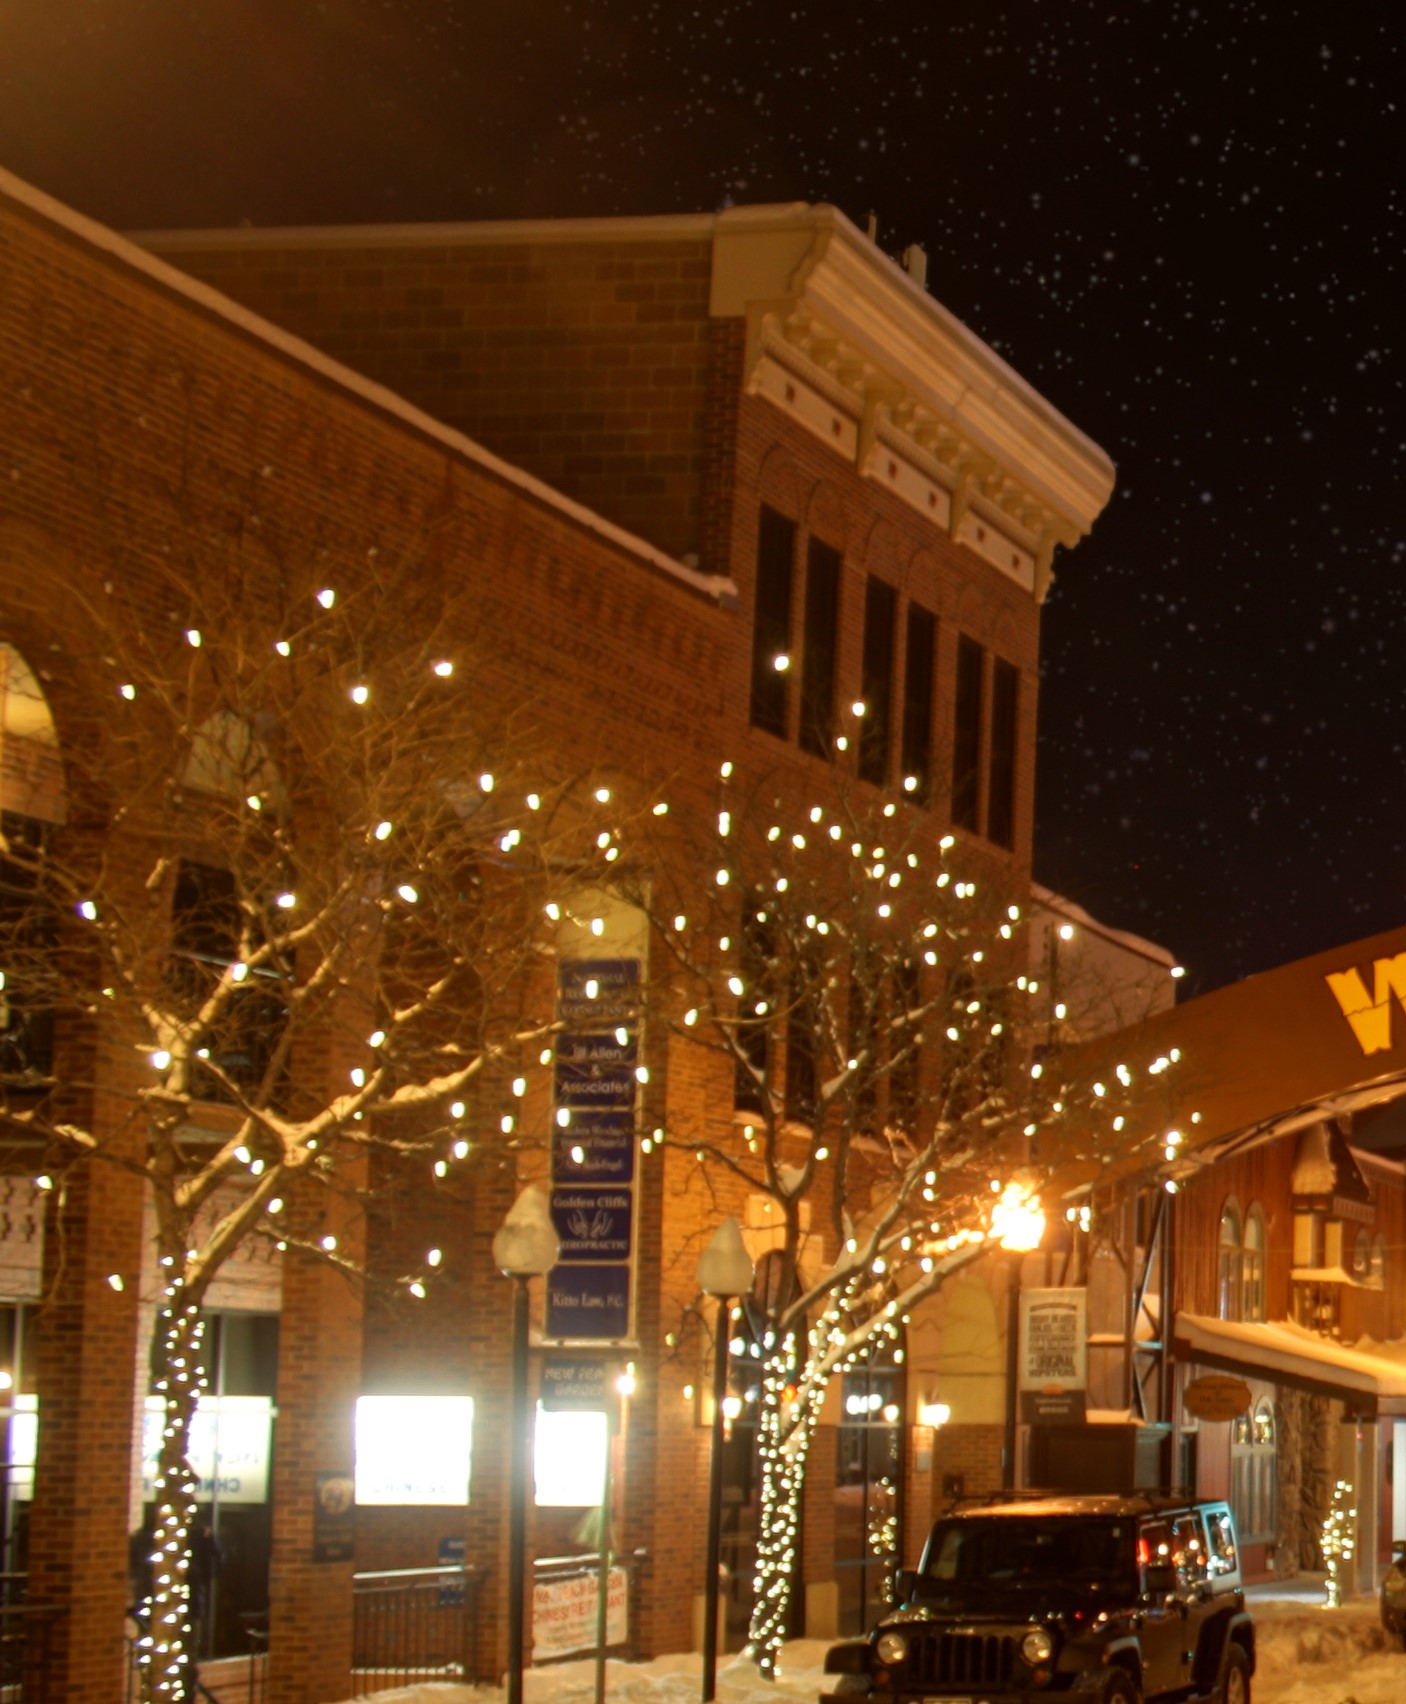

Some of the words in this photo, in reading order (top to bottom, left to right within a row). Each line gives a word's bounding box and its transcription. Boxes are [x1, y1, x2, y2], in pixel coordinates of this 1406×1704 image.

[590, 1047, 622, 1060] Allen
[561, 1081, 630, 1094] Associates
[553, 1196, 594, 1209] Golden
[597, 1195, 628, 1209] Cliffs
[552, 1292, 579, 1307] Kitto
[581, 1291, 605, 1308] Law,
